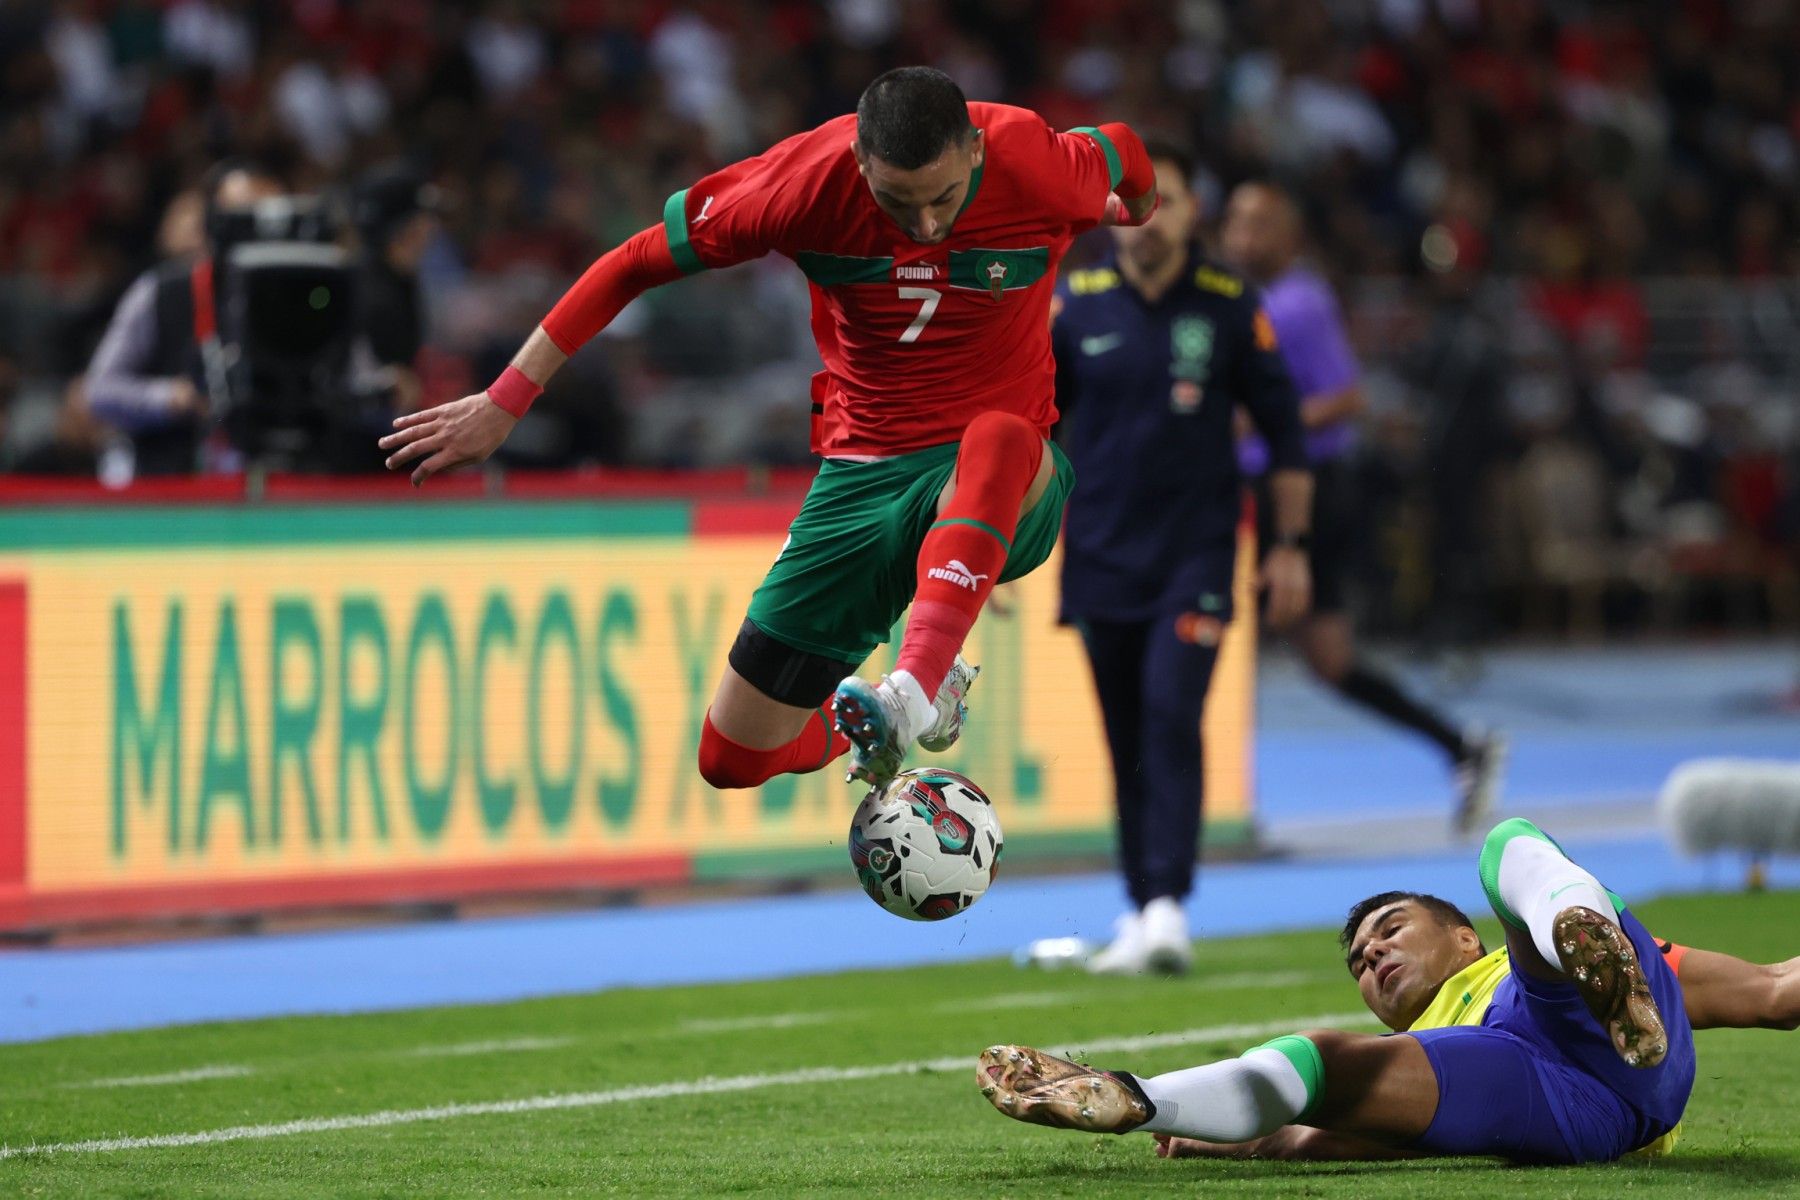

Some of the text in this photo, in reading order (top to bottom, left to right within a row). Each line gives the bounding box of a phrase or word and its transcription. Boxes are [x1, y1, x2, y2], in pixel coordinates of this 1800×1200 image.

[896, 266, 934, 280] PUMA
[898, 286, 942, 343] 7
[927, 567, 971, 589] PUMA
[108, 583, 643, 860] MARROCOS
[667, 583, 727, 825] X
